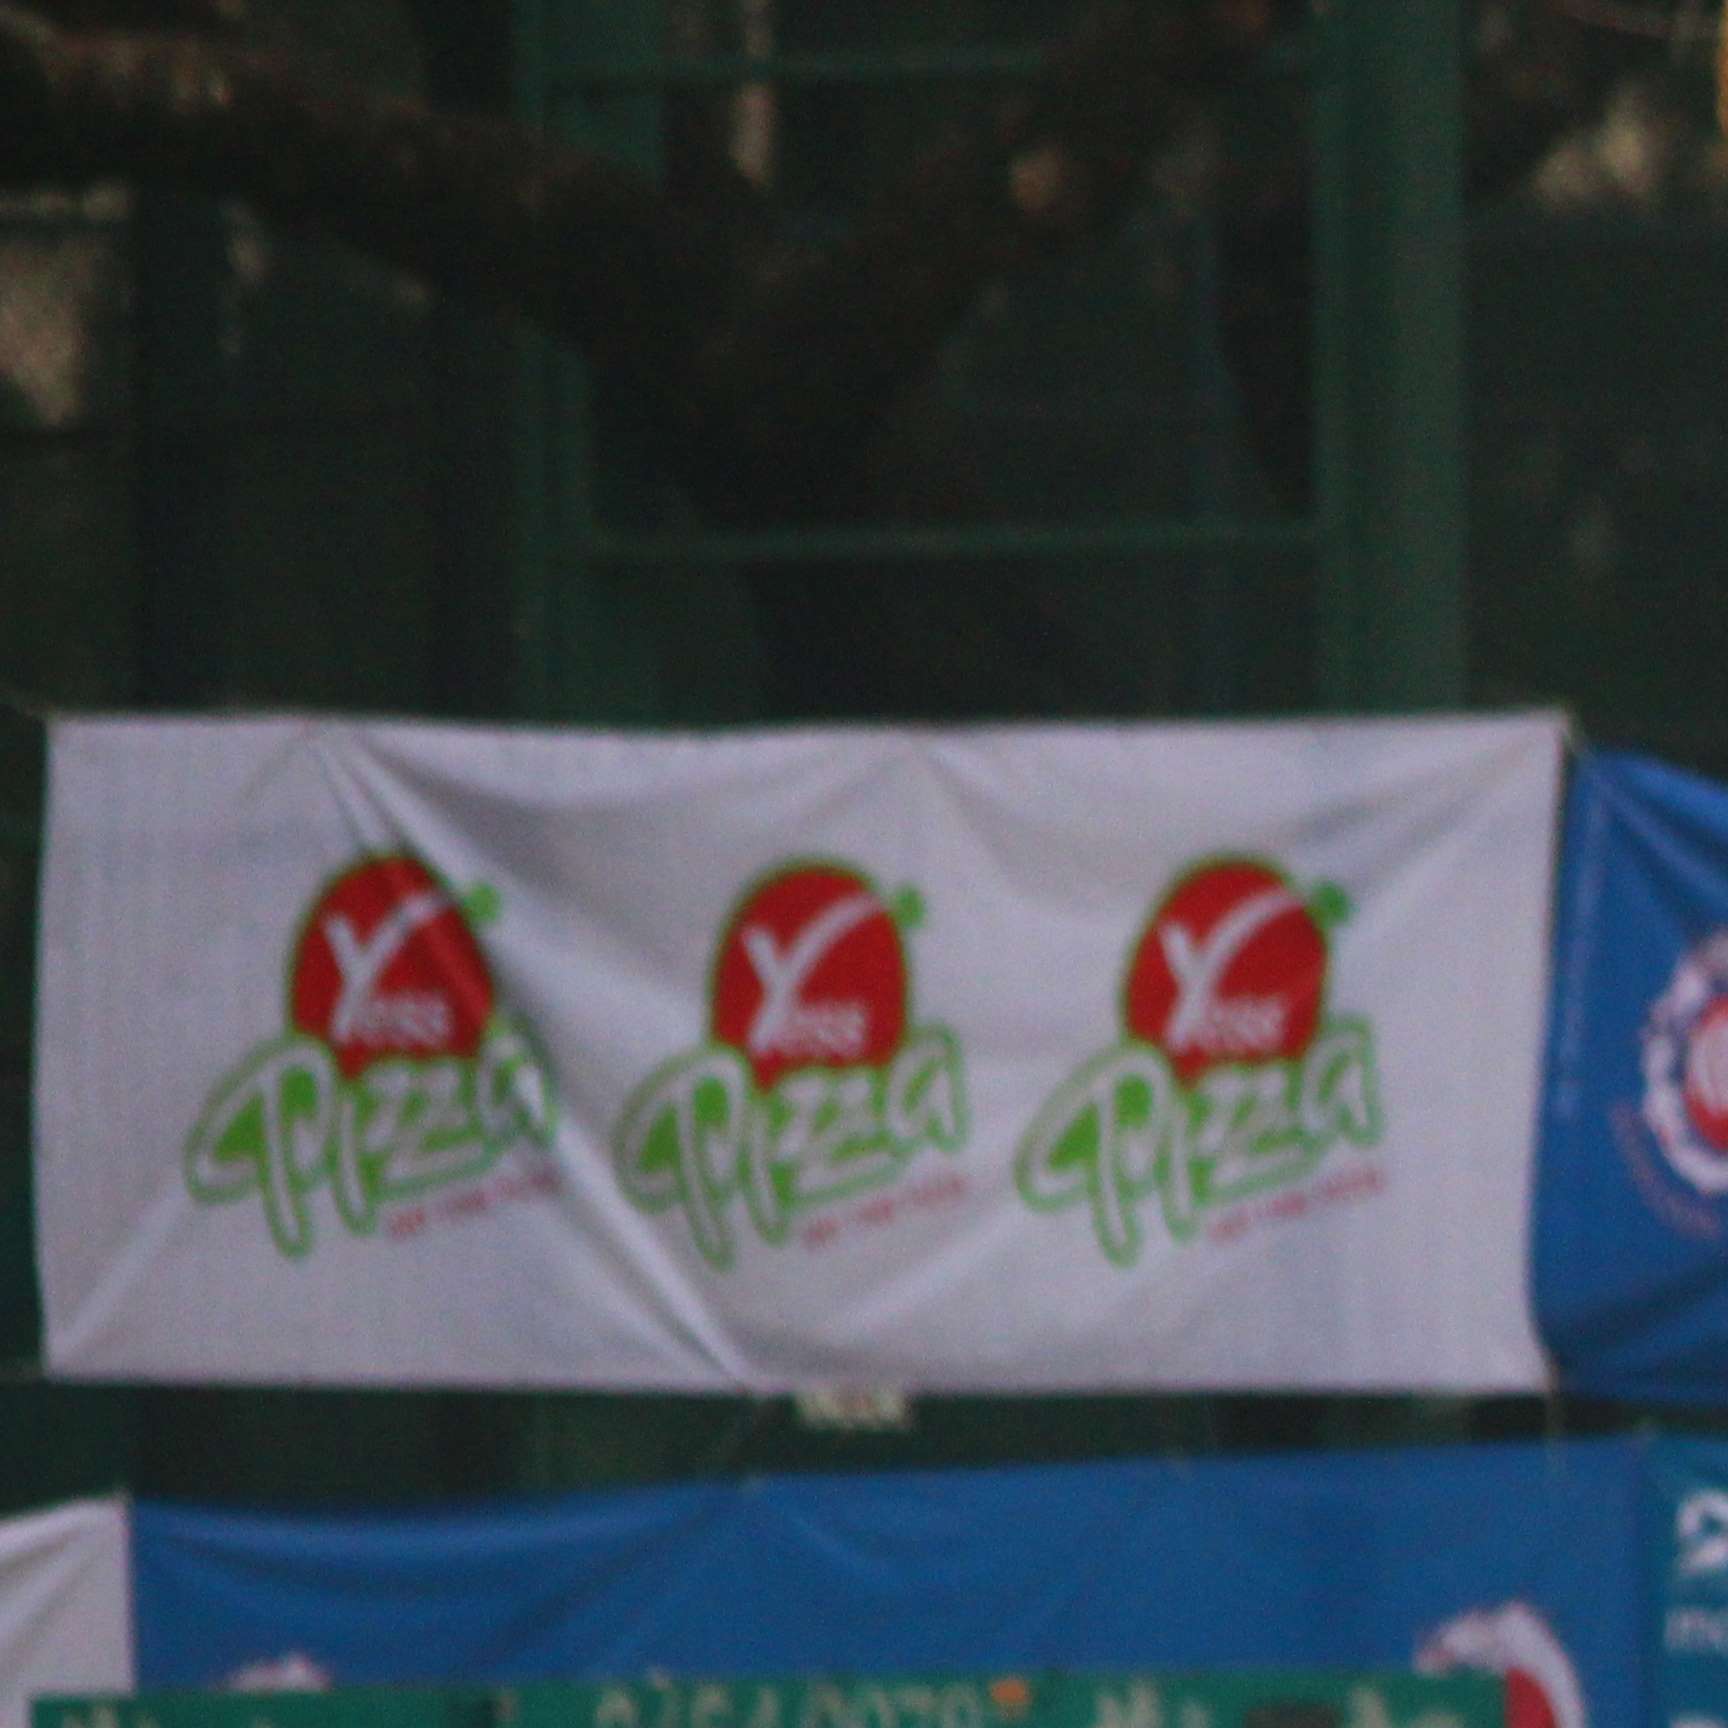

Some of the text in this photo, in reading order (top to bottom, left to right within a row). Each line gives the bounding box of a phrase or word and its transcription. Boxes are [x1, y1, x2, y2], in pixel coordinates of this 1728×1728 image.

[186, 1010, 560, 1258] Pizza
[612, 1022, 970, 1270] Pizza
[1013, 1012, 1387, 1268] Pizza
